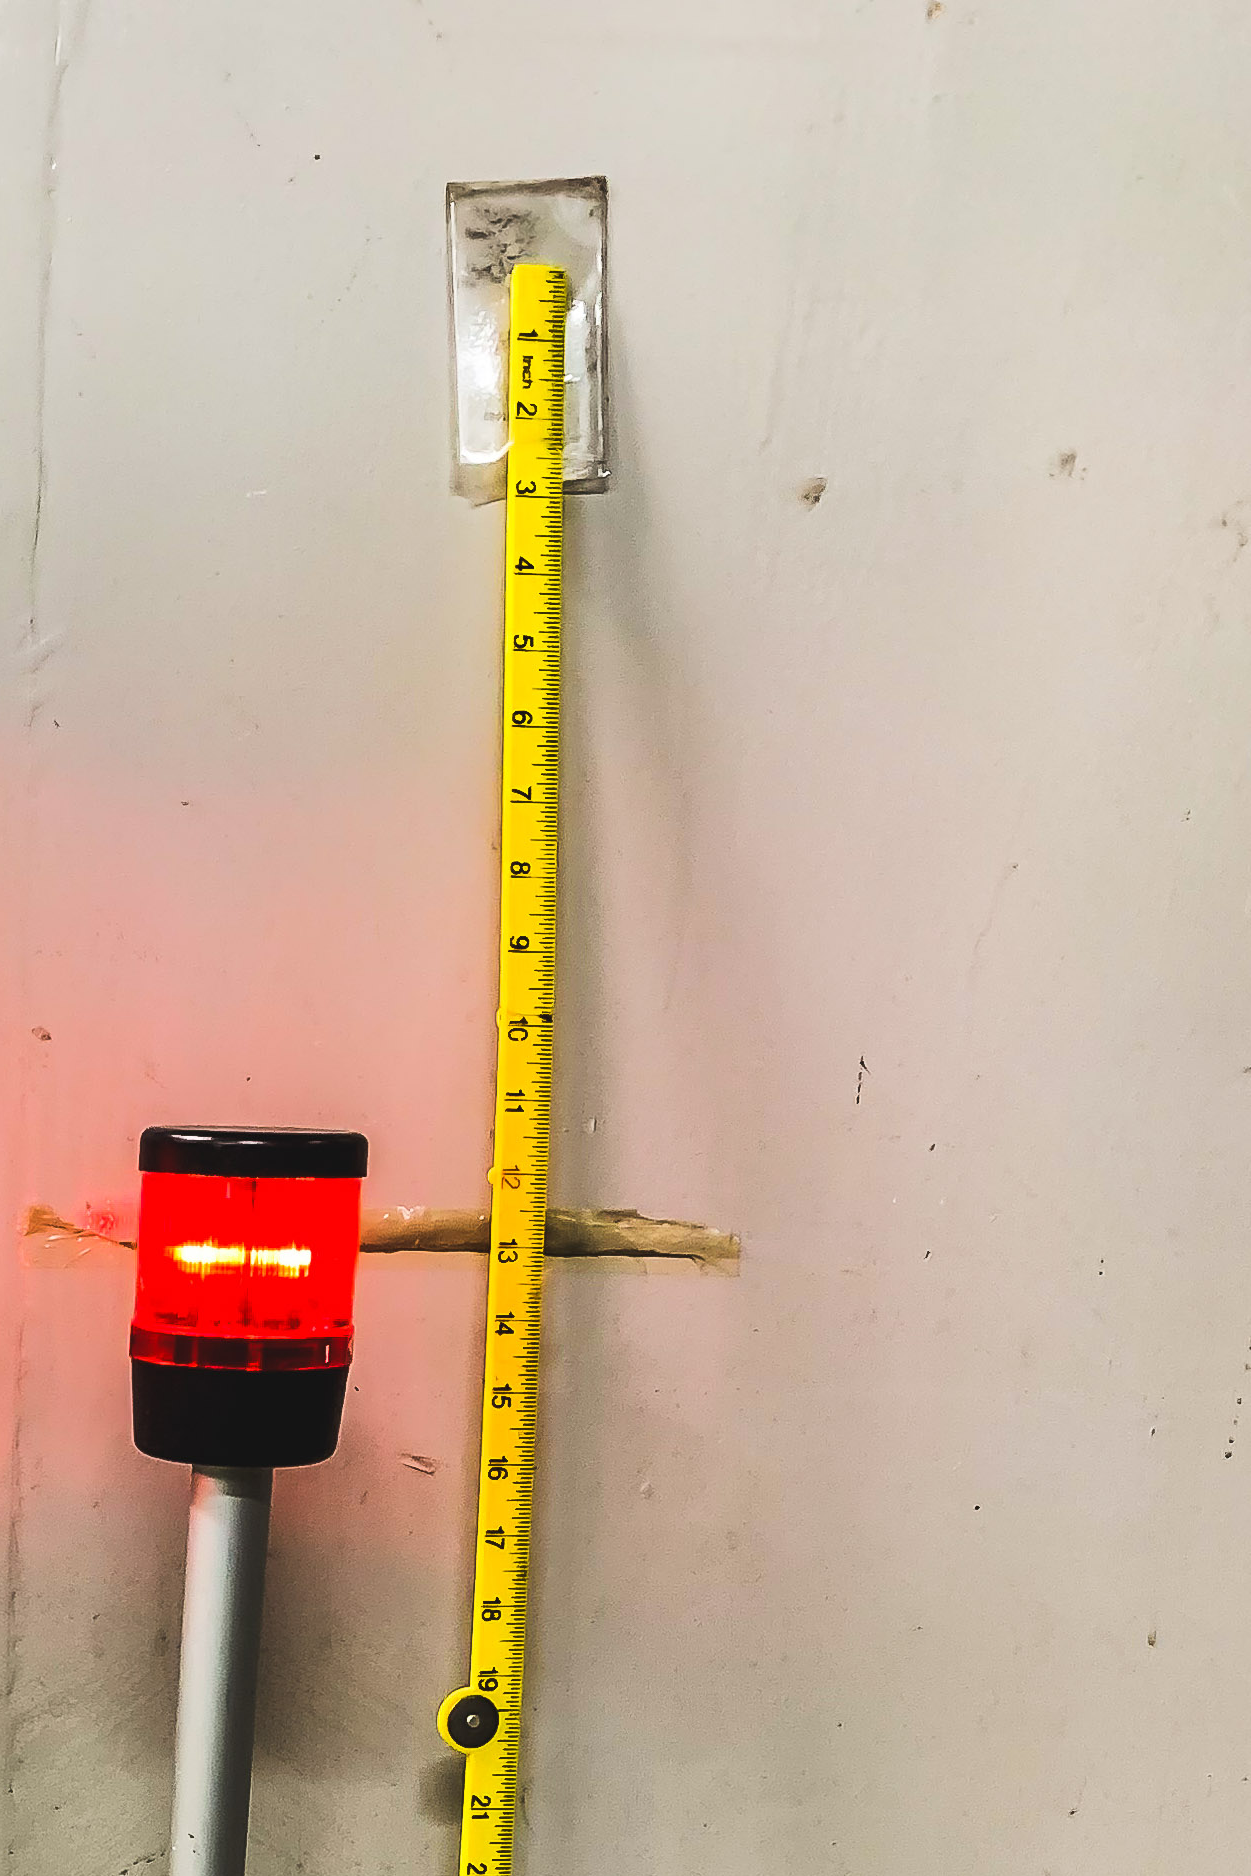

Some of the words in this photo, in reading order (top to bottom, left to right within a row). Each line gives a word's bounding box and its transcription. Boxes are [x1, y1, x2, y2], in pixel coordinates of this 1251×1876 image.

[516, 401, 537, 417] 2
[516, 480, 536, 495] 3
[515, 556, 534, 571] 4
[514, 634, 534, 649] 5
[512, 710, 533, 725] 6
[511, 786, 532, 800] 7
[510, 861, 531, 875] 8
[510, 936, 530, 950] 9
[508, 1016, 528, 1042] 10
[505, 1089, 525, 1112] 11
[501, 1165, 521, 1189] 12
[498, 1239, 518, 1263] 13
[495, 1311, 515, 1336] 14
[492, 1383, 512, 1409] 15
[488, 1456, 508, 1480] 16
[485, 1526, 505, 1549] 17
[481, 1597, 501, 1621] 18
[478, 1667, 498, 1691] 19
[471, 1795, 491, 1819] 21
